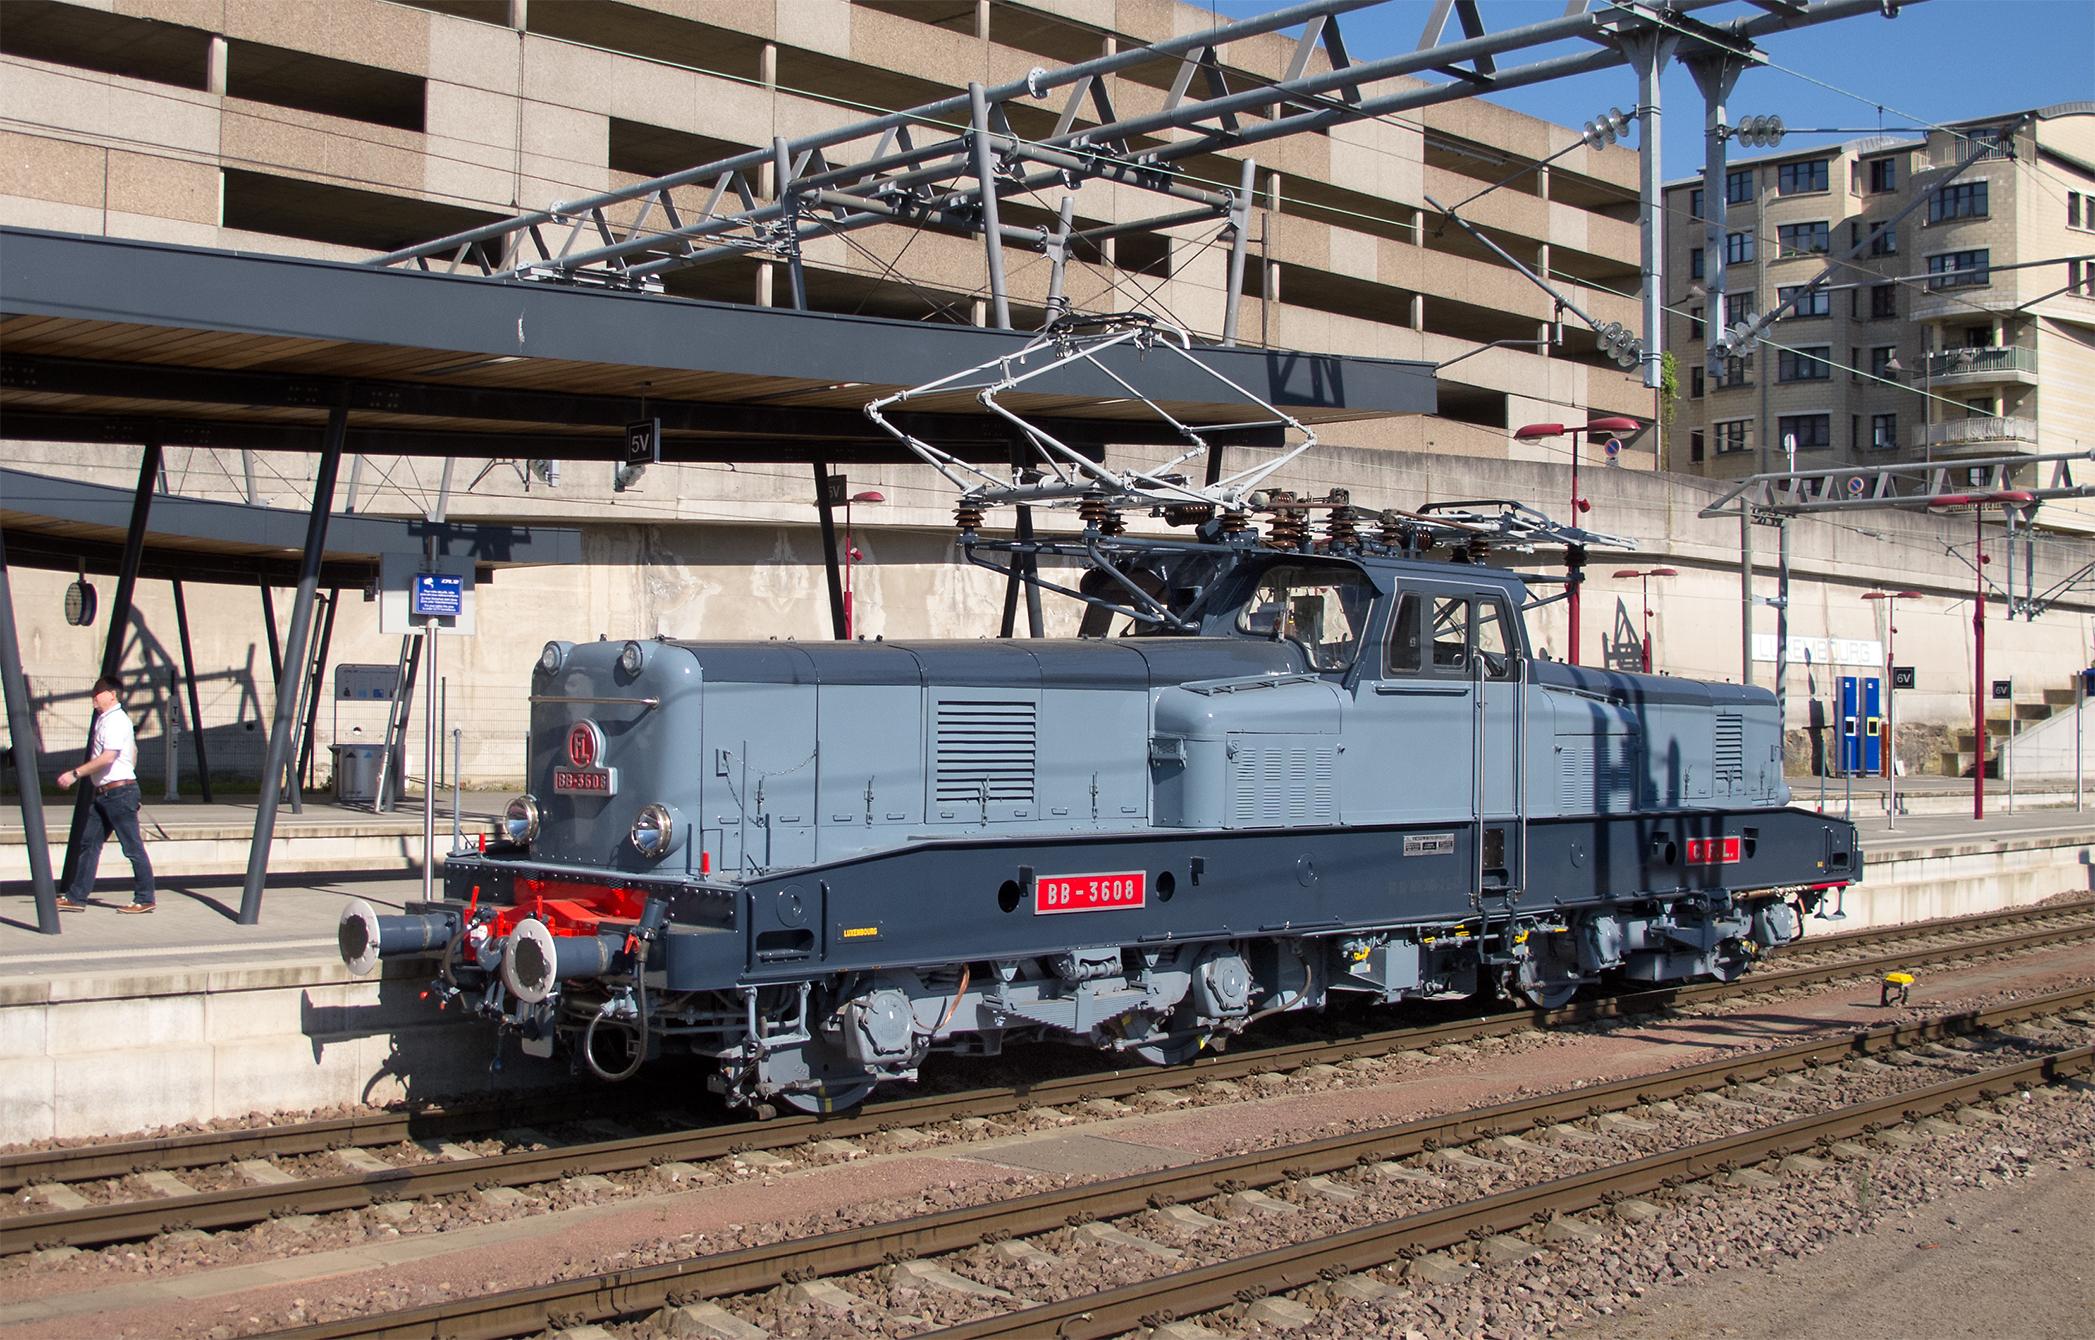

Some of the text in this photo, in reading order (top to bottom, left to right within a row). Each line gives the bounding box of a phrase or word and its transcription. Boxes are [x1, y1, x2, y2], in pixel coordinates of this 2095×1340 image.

[631, 433, 650, 453] 5V
[1896, 673, 1911, 683] 6V
[1995, 686, 2008, 695] 6V
[558, 773, 607, 789] BB-3608
